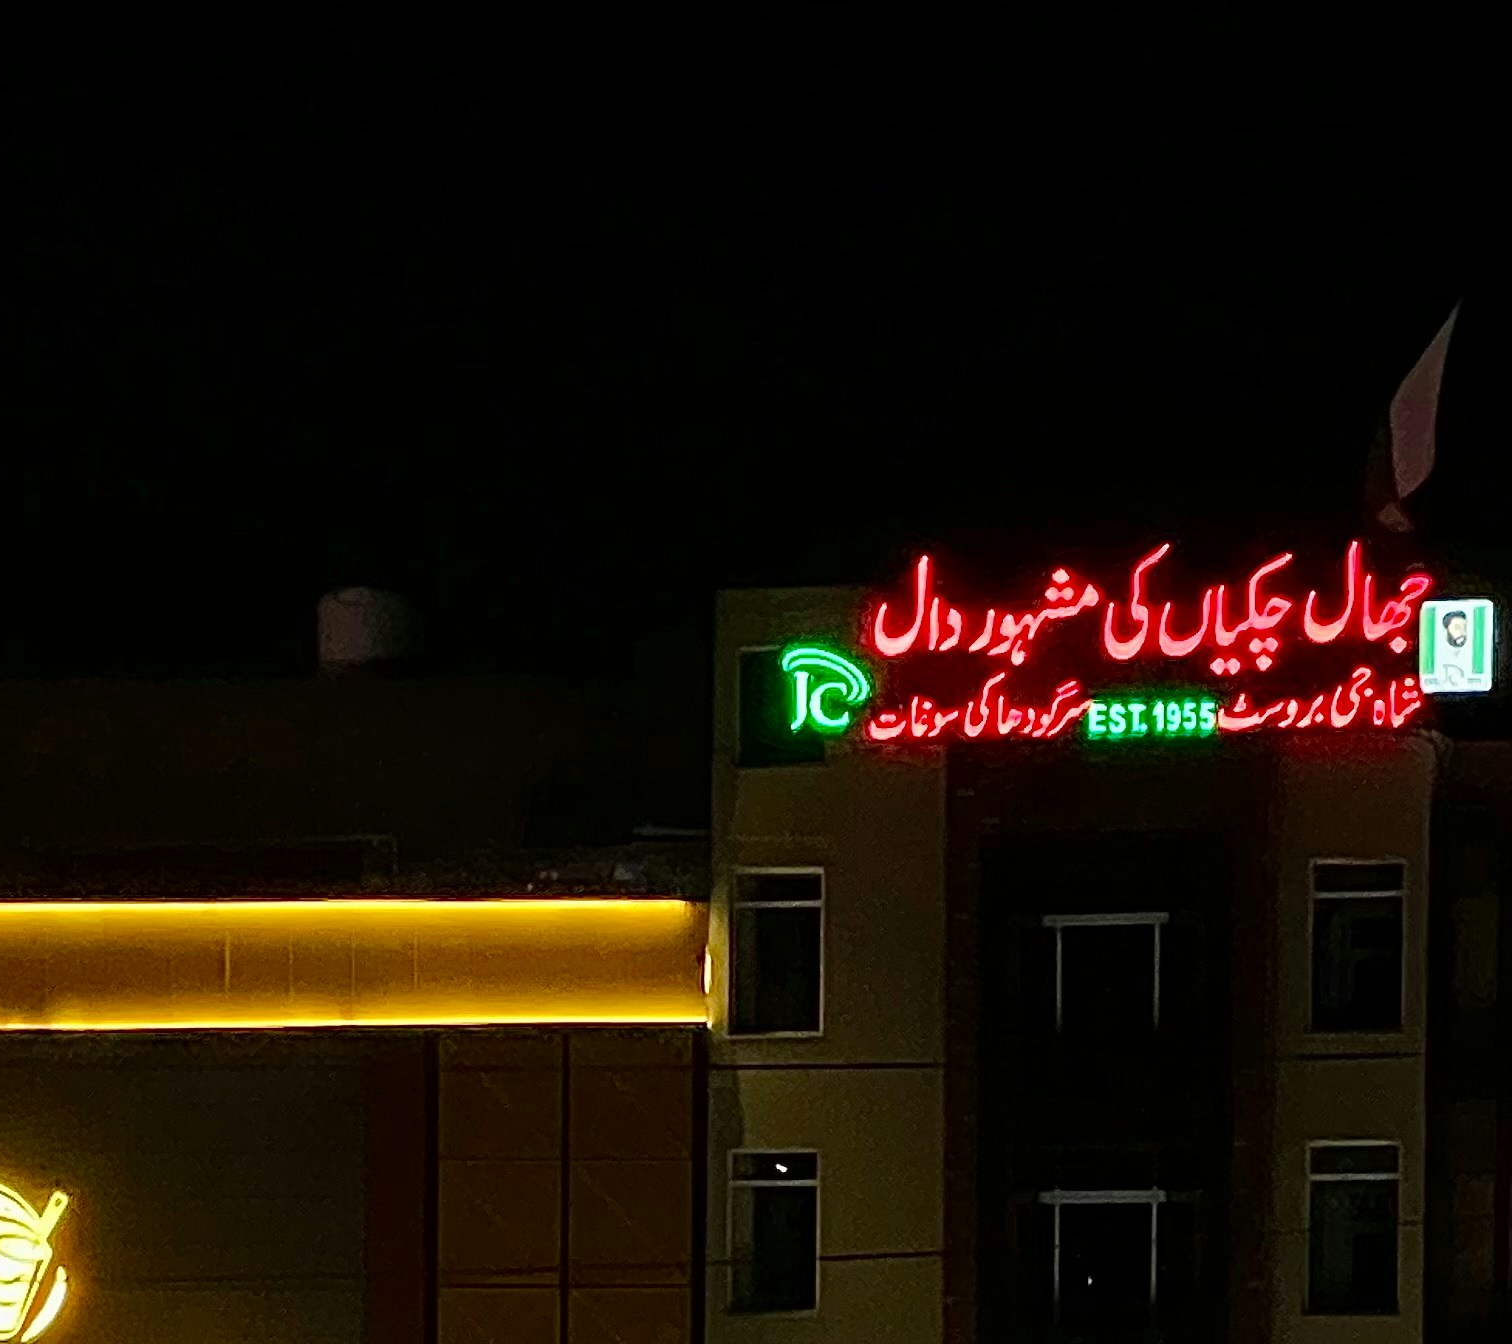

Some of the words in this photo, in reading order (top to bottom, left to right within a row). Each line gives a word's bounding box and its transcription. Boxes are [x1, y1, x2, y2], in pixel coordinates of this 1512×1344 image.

[874, 555, 962, 656] دال
[968, 568, 1100, 667] مشہور
[1104, 543, 1170, 660] کی
[1303, 540, 1432, 654] جھال
[963, 672, 1006, 737] کی
[1150, 699, 1217, 734] 1955
